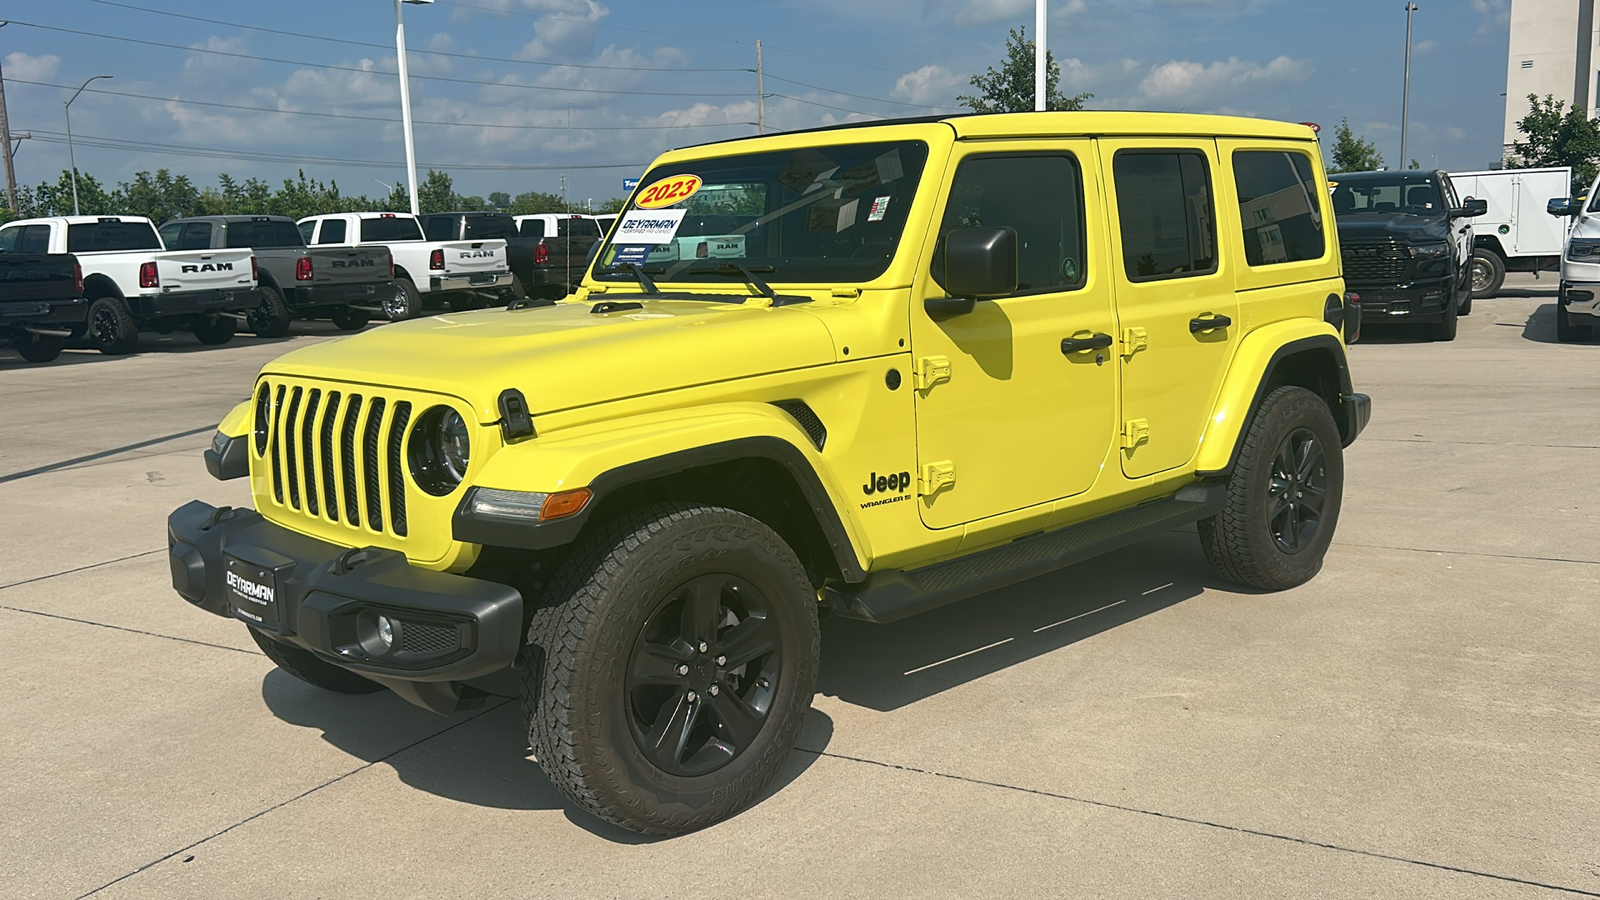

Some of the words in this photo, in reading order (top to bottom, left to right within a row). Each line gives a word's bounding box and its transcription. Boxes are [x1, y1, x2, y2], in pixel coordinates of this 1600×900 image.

[640, 179, 697, 204] 2023
[623, 219, 678, 228] DEYARMAN
[459, 250, 494, 258] RAM
[181, 263, 233, 273] RAM
[332, 259, 375, 268] RAM
[863, 471, 910, 495] Jeep
[860, 495, 903, 509] WRANGLER
[227, 570, 274, 602] DEYARMAN
